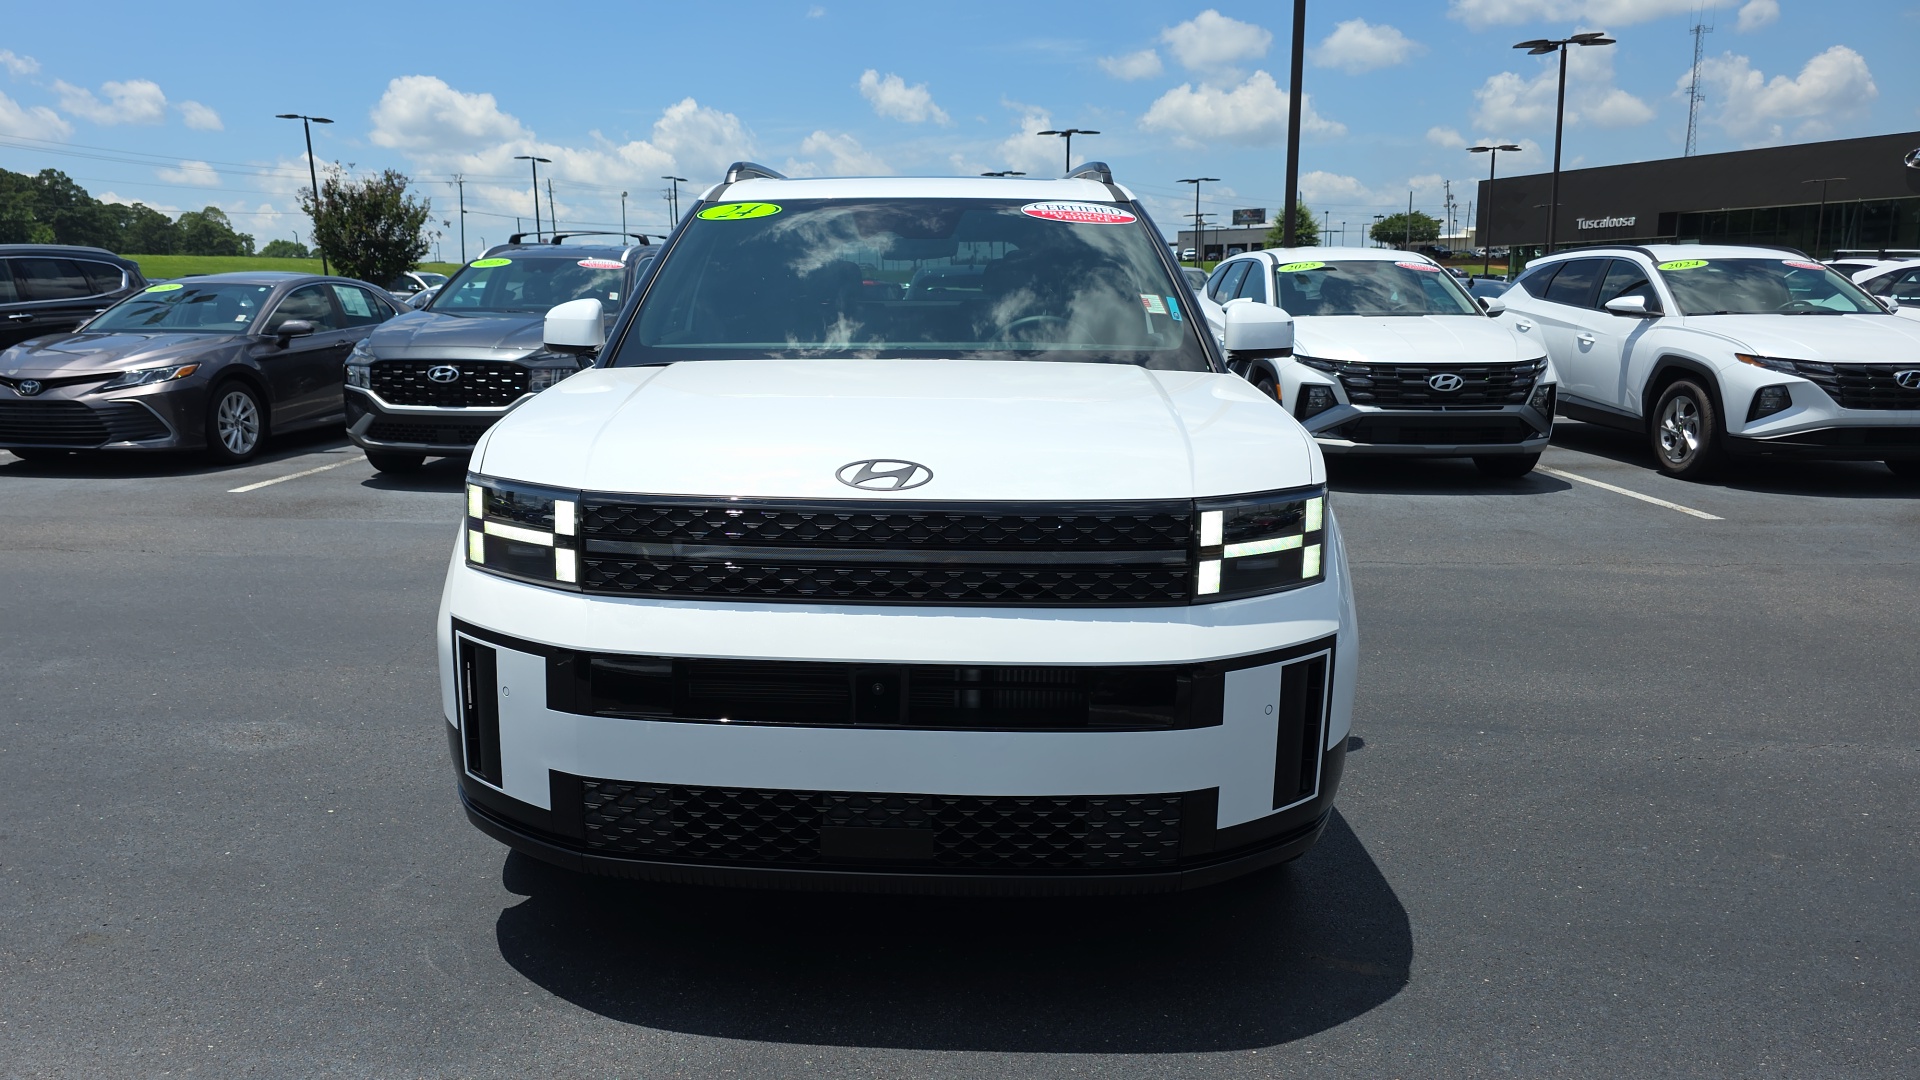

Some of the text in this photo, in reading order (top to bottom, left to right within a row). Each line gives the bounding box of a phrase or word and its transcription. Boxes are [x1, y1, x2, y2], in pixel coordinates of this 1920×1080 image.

[1034, 205, 1121, 216] CERTIFIED
[1041, 211, 1121, 221] PRE-OWNED
[1054, 214, 1112, 223] VEHICLE
[1576, 216, 1636, 230] Tuscaloosa
[1287, 263, 1316, 271] 2025
[1667, 260, 1699, 270] 2024
